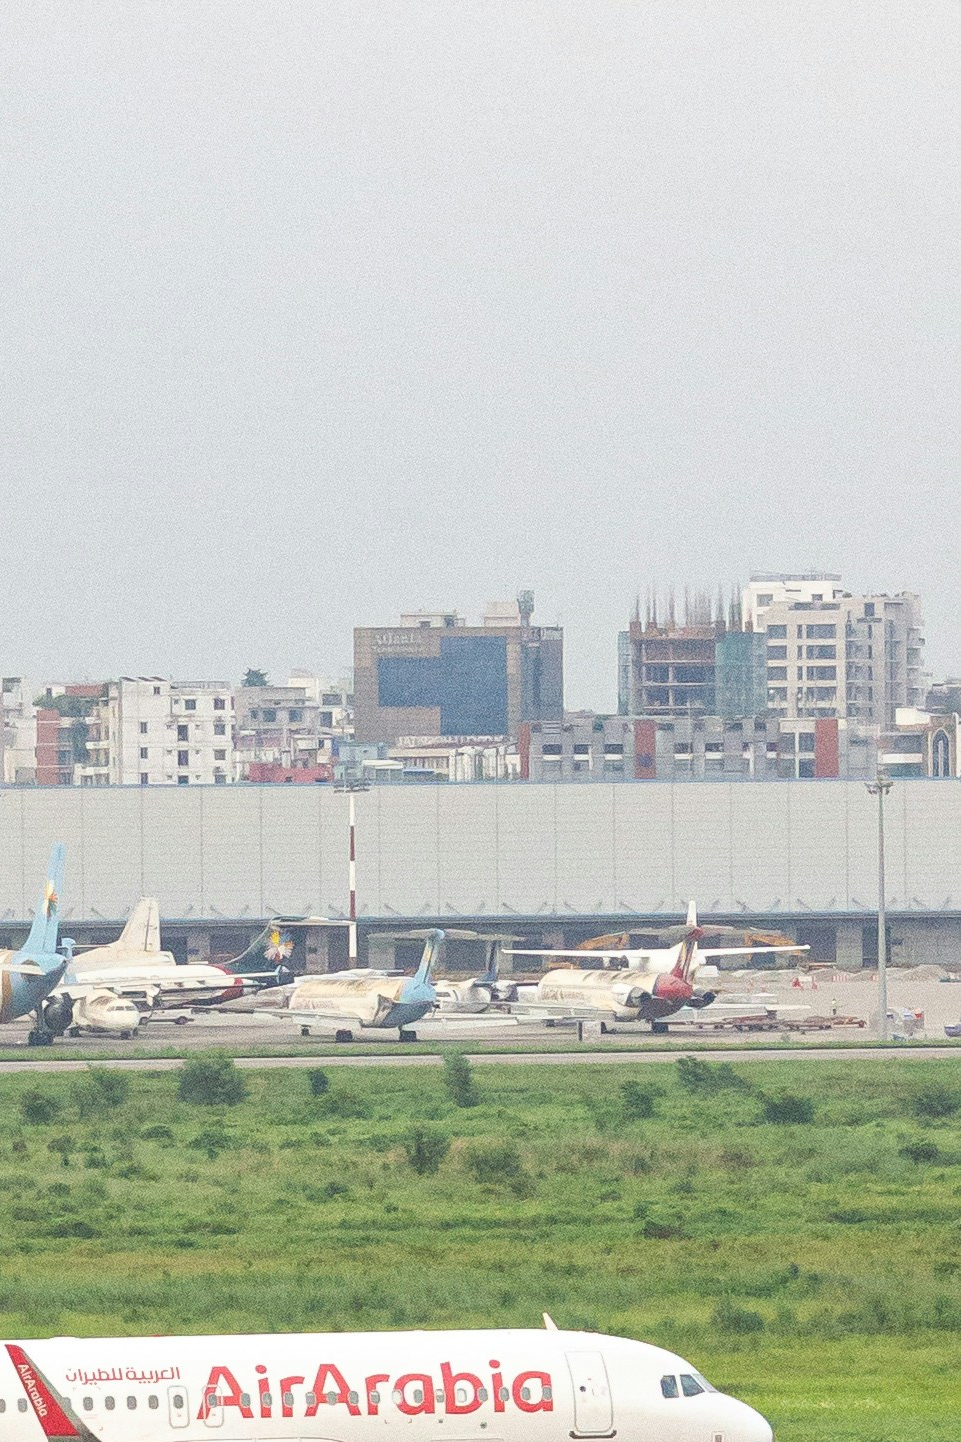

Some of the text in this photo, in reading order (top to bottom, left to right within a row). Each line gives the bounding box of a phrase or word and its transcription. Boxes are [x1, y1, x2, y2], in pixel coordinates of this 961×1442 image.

[17, 1363, 48, 1418] AirArabia
[65, 1366, 181, 1385] العربية للطيران
[196, 1359, 554, 1420] AirArabia
